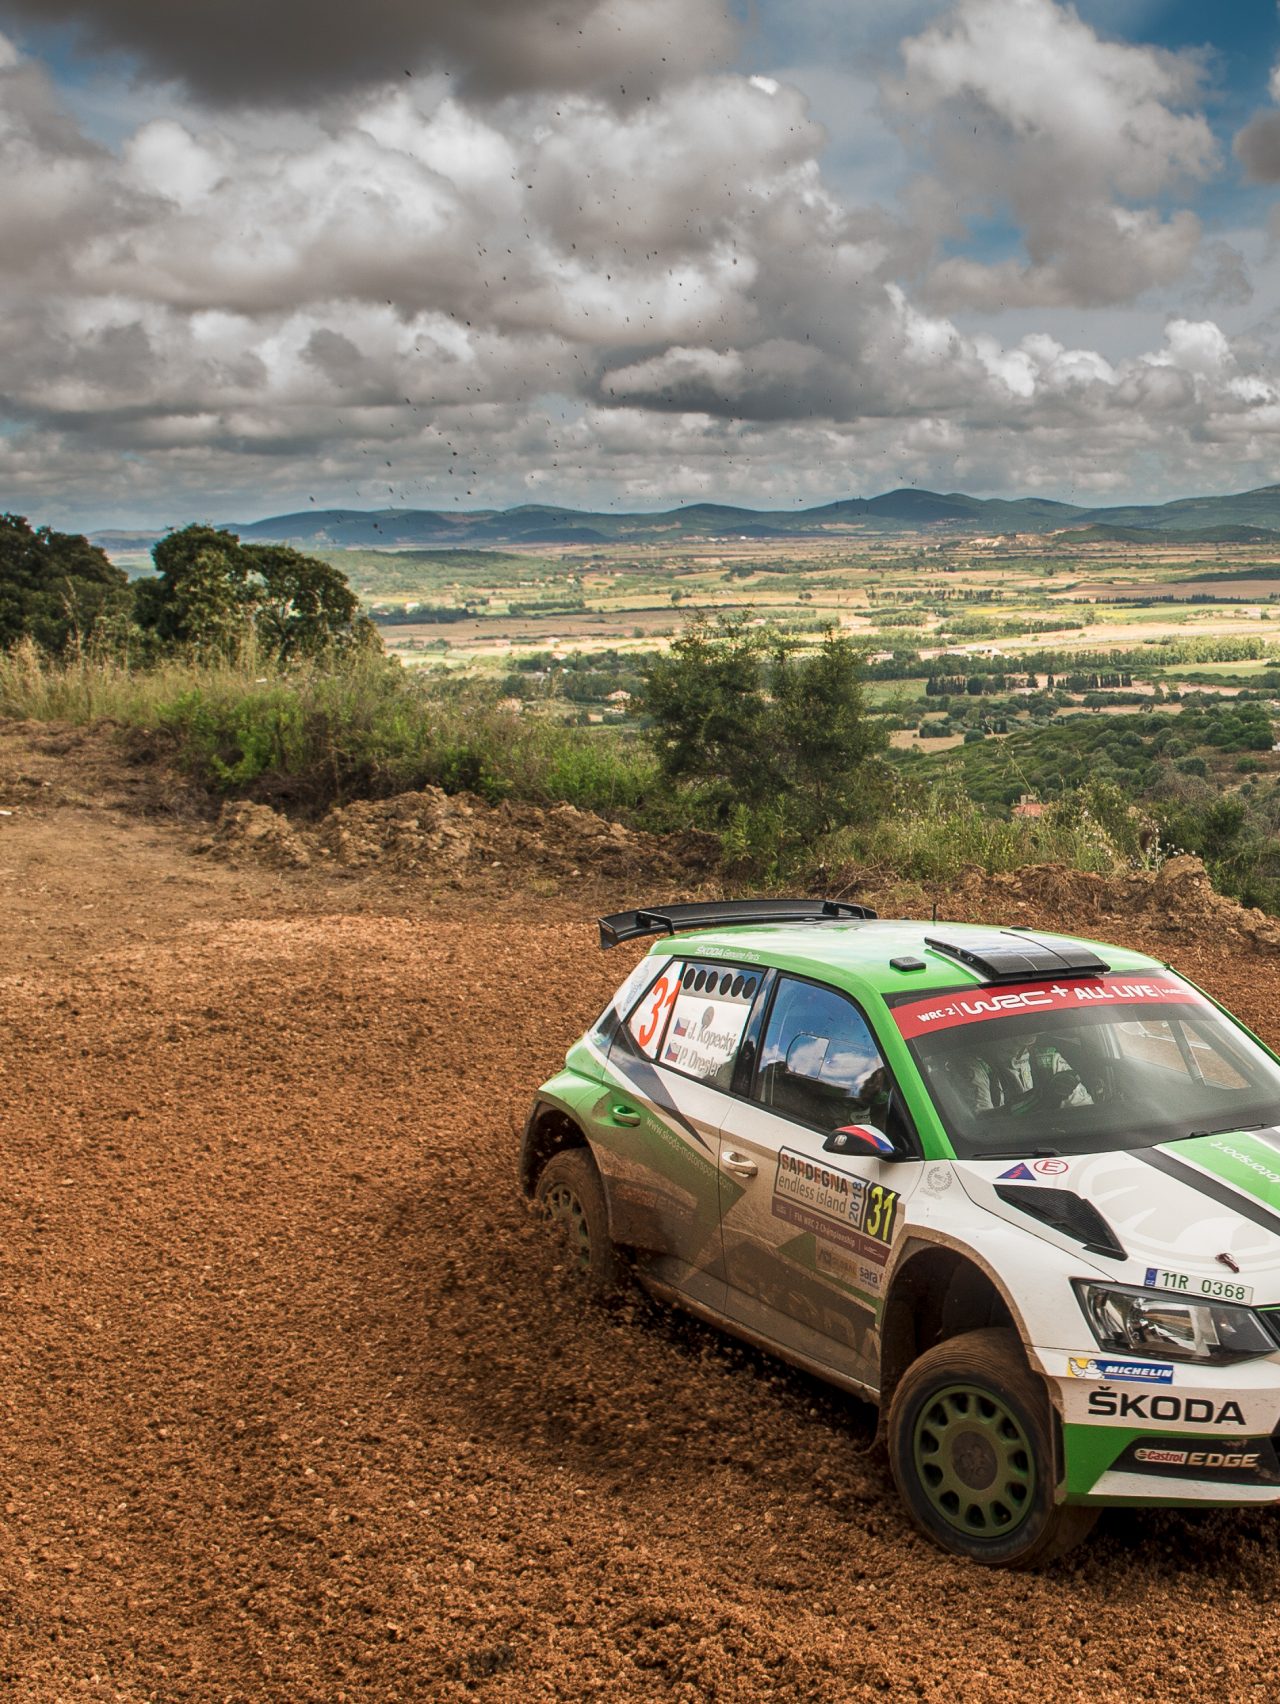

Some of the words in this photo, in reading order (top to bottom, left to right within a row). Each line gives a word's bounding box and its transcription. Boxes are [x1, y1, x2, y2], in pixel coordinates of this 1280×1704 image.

[1074, 986, 1114, 1000] ALL
[1111, 985, 1159, 998] LIVE
[917, 1008, 945, 1022] WRC
[945, 1007, 955, 1016] 2
[687, 1021, 697, 1041] J.
[698, 1027, 737, 1056] Kopecký
[677, 1047, 687, 1065] P.
[687, 1051, 723, 1077] Dresler
[780, 1153, 849, 1196] SARDEGNA
[1042, 1160, 1061, 1172] E
[778, 1174, 815, 1201] endless
[816, 1190, 848, 1214] island
[848, 1181, 863, 1223] 2018
[867, 1186, 896, 1240] 31
[859, 1266, 878, 1284] sara
[1162, 1272, 1189, 1290] 11R
[1201, 1279, 1246, 1301] 0368
[1105, 1365, 1173, 1378] MICHELIN
[1088, 1386, 1247, 1426] ŠKODA
[1147, 1450, 1184, 1464] Castrol
[1187, 1452, 1260, 1468] EDGE
